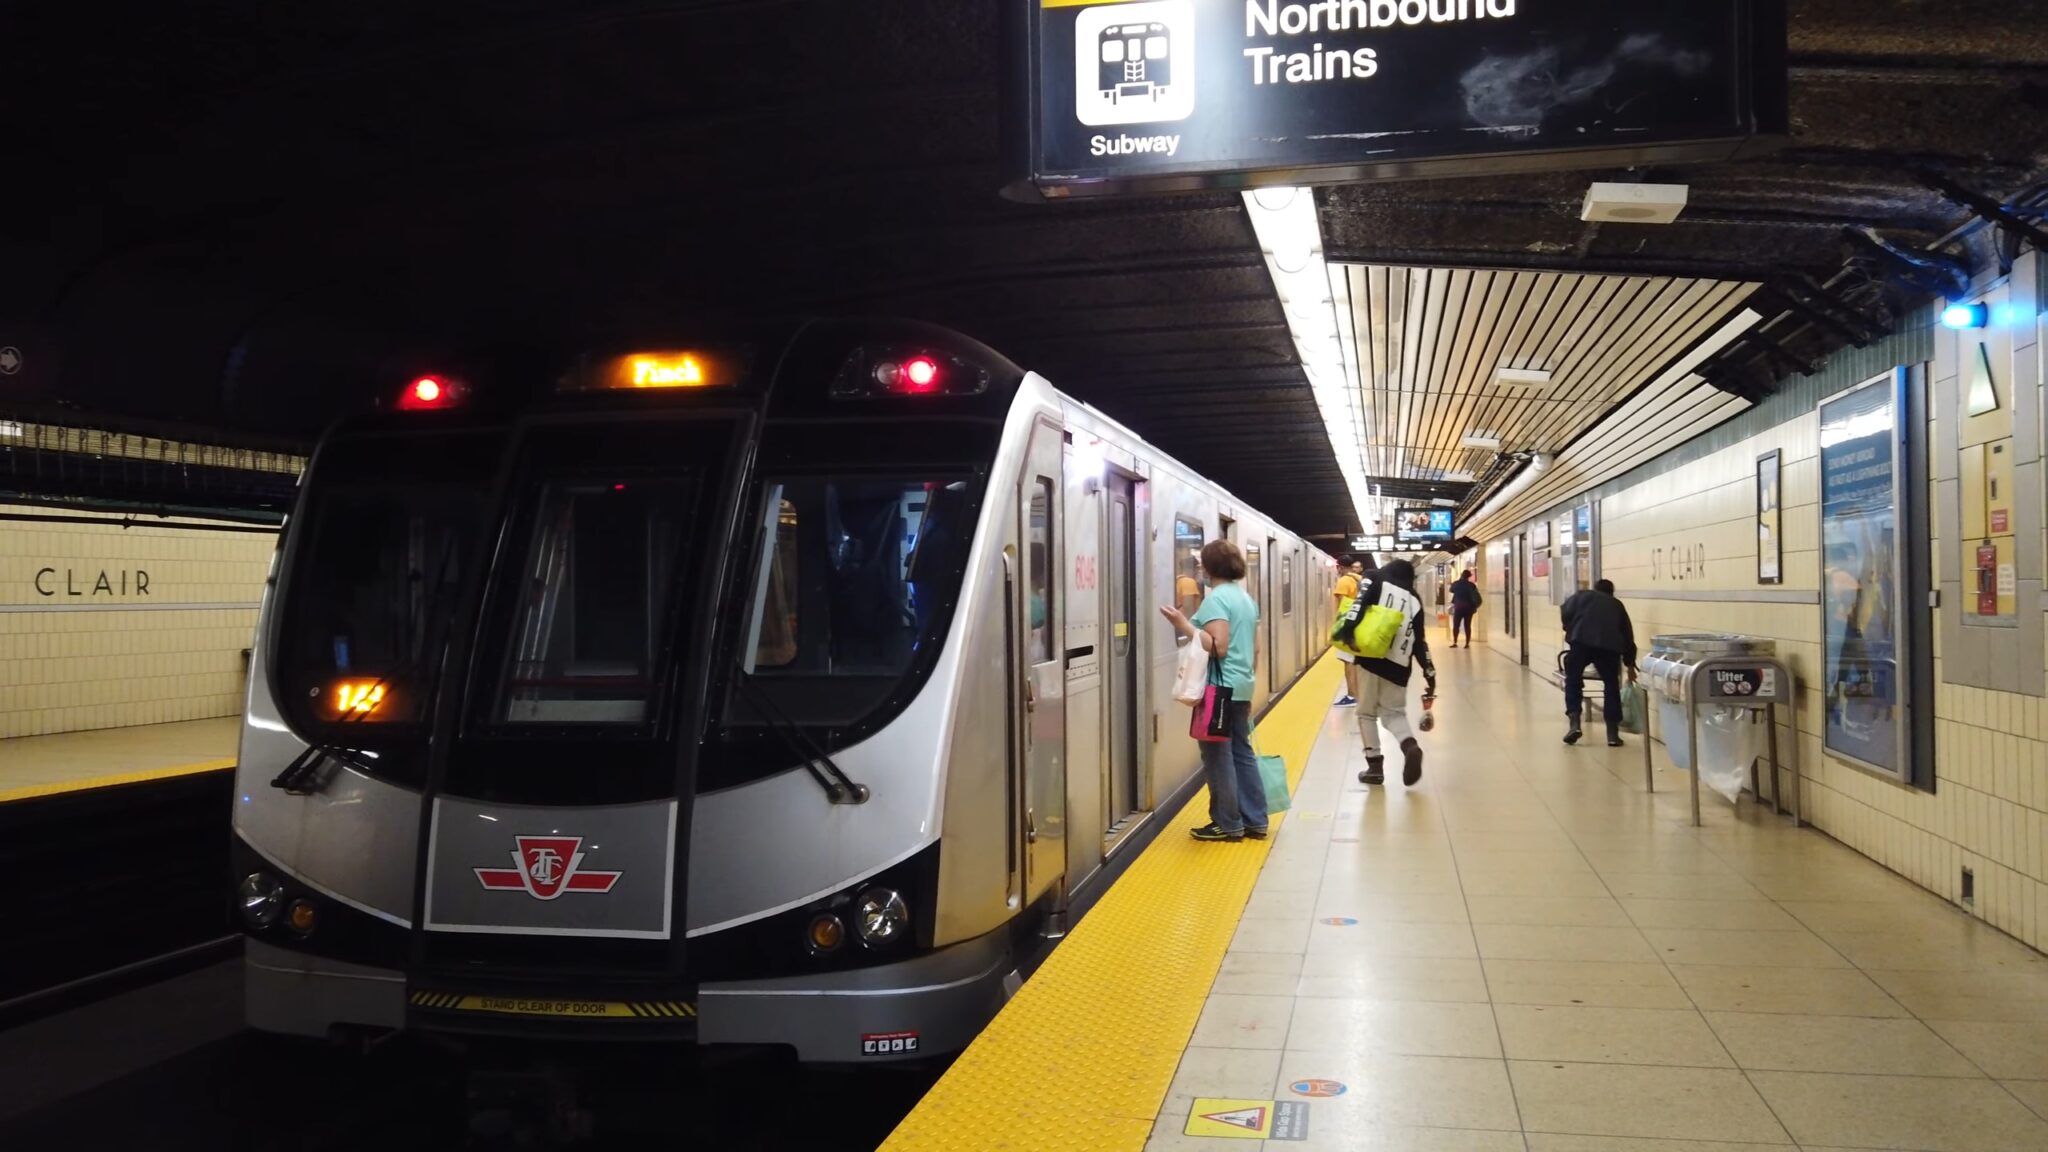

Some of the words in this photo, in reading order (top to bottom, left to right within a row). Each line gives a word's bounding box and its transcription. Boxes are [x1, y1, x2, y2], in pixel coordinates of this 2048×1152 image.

[1243, 43, 1378, 85] Trains
[1090, 133, 1180, 156] Subway
[1670, 543, 1705, 581] CLAIR
[34, 567, 151, 597] CLAIR
[1716, 670, 1745, 682] Litter
[481, 999, 515, 1010] STAND
[517, 1000, 553, 1012] CLEAR
[555, 1002, 571, 1013] OF
[573, 1002, 606, 1014] DOOR
